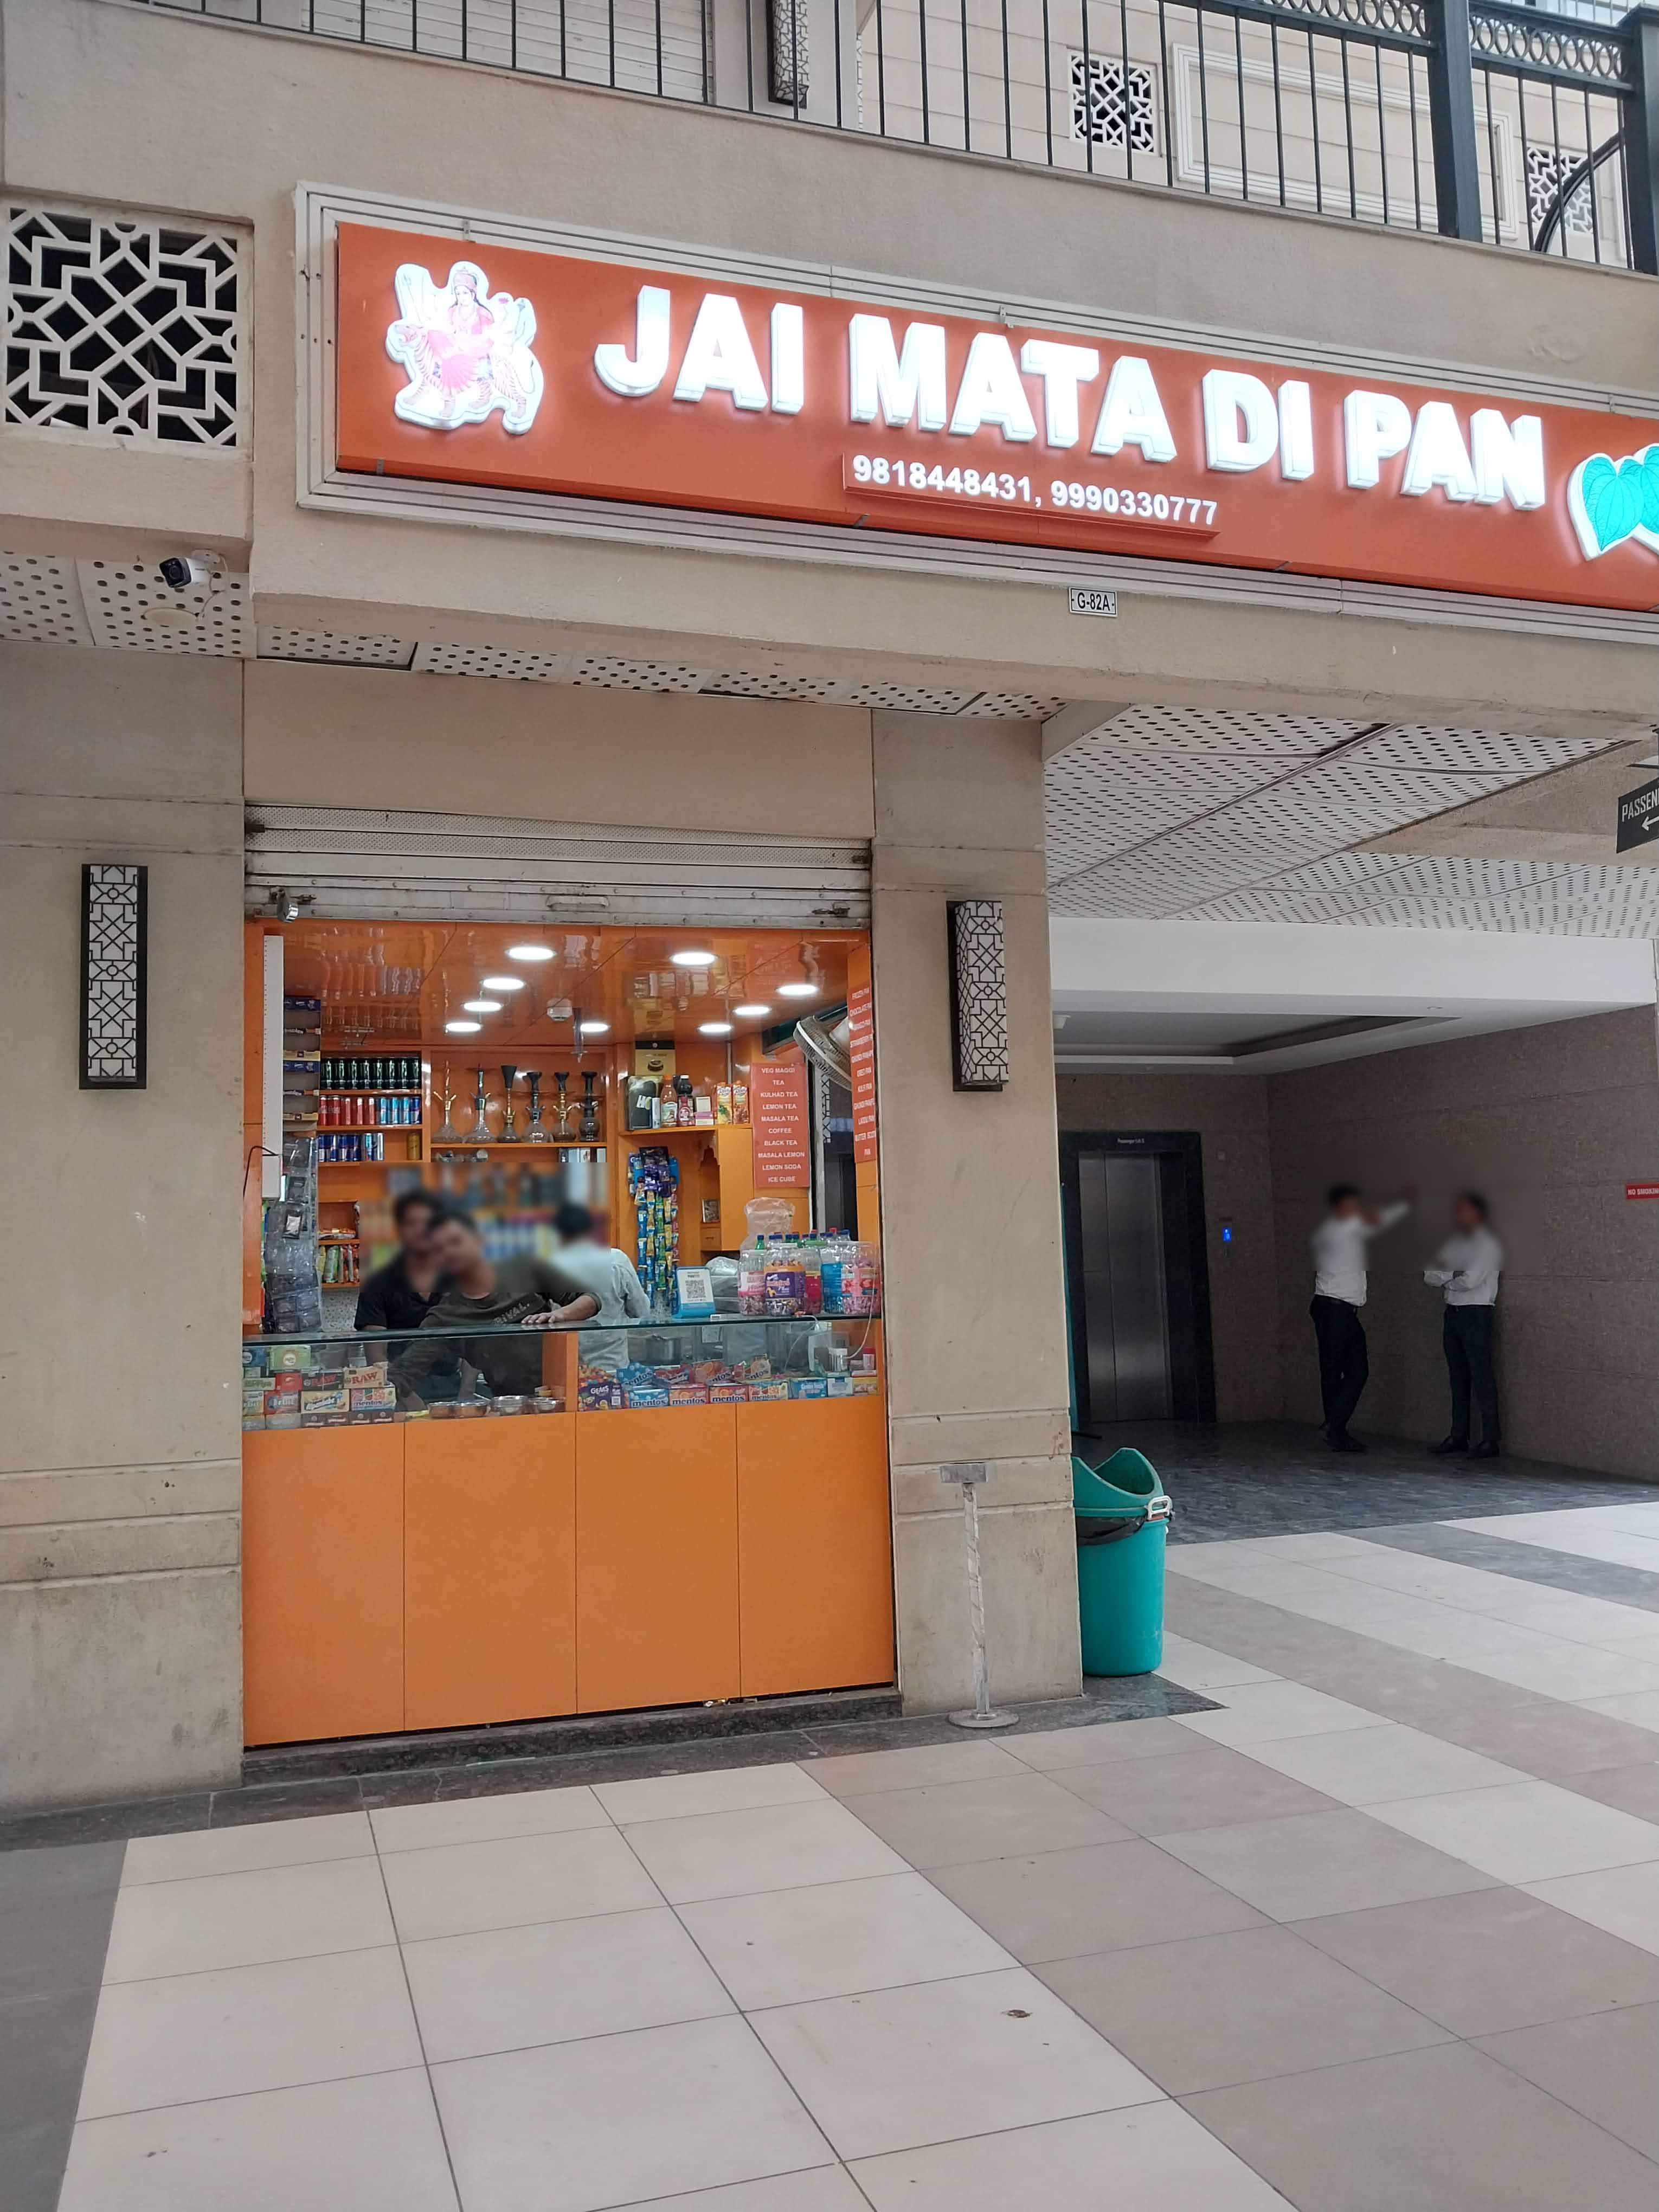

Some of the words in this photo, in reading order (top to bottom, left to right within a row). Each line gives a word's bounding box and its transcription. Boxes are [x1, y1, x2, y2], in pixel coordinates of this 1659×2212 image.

[594, 285, 804, 415] JAI
[848, 313, 1178, 462] MATA
[1202, 369, 1315, 481] DI
[1343, 389, 1545, 511] PAN
[852, 454, 1042, 507] 9818448431,
[1051, 480, 1218, 525] 9990330777
[1077, 592, 1110, 611] G-82A
[1622, 787, 1659, 822] PASSEN
[351, 1371, 378, 1384] RAW
[632, 1399, 667, 1407] mentos
